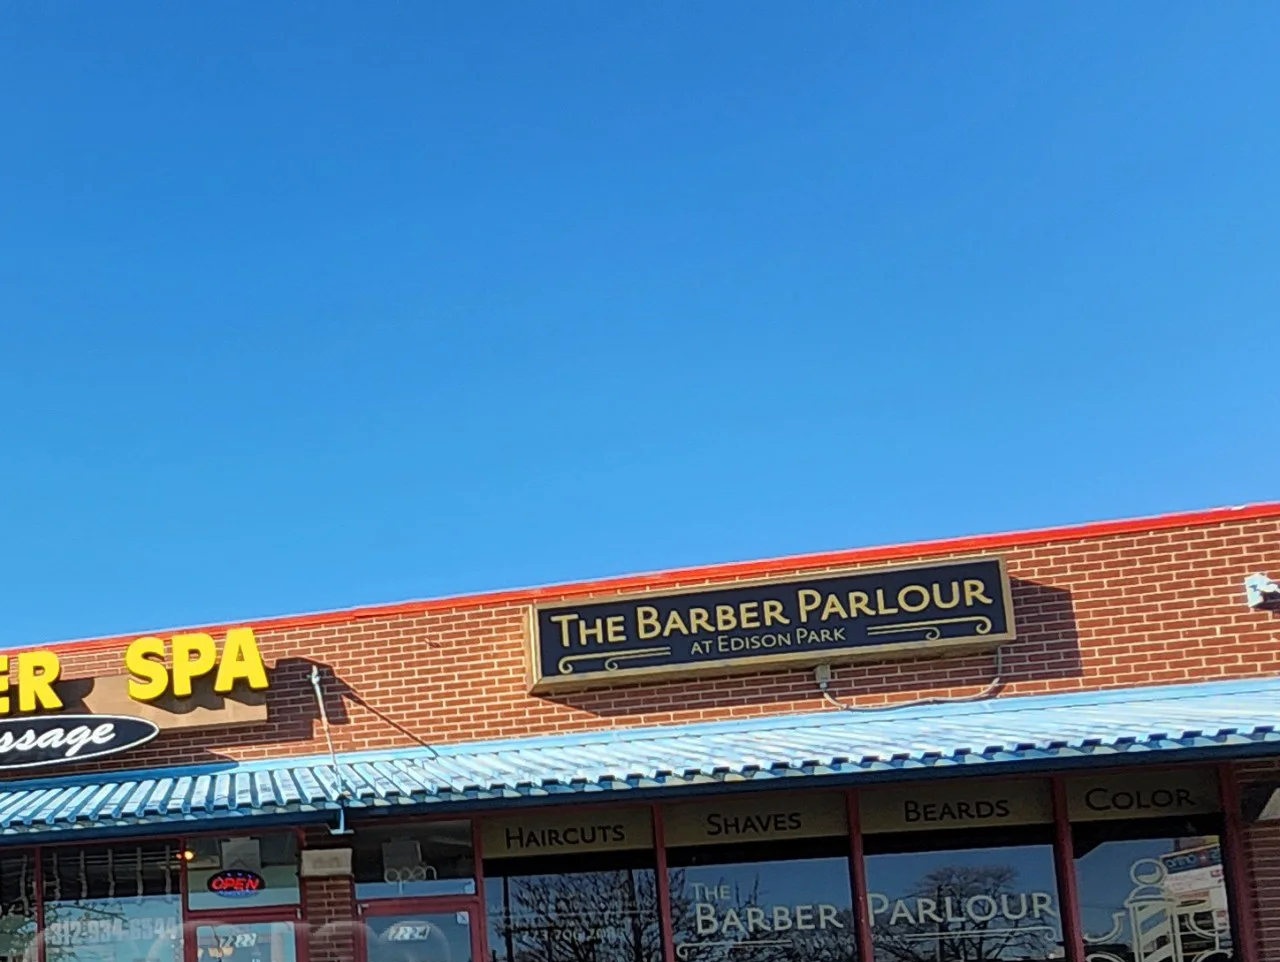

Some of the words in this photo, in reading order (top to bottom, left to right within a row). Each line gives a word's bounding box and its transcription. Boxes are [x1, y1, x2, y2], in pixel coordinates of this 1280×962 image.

[549, 612, 627, 648] THE
[636, 599, 790, 641] BARBER
[798, 579, 994, 624] PARLOUR
[690, 638, 715, 656] AT
[718, 631, 792, 653] EDISON
[796, 626, 846, 645] PARK
[124, 627, 270, 701] SPA
[904, 799, 1011, 823] BEARDS
[1084, 787, 1197, 812] COLOR
[705, 811, 803, 836] SHAVES
[504, 824, 626, 850] HAIRCUTS
[211, 876, 260, 891] OPEN
[694, 902, 845, 935] BARBER
[867, 891, 1060, 927] PARLOUR
